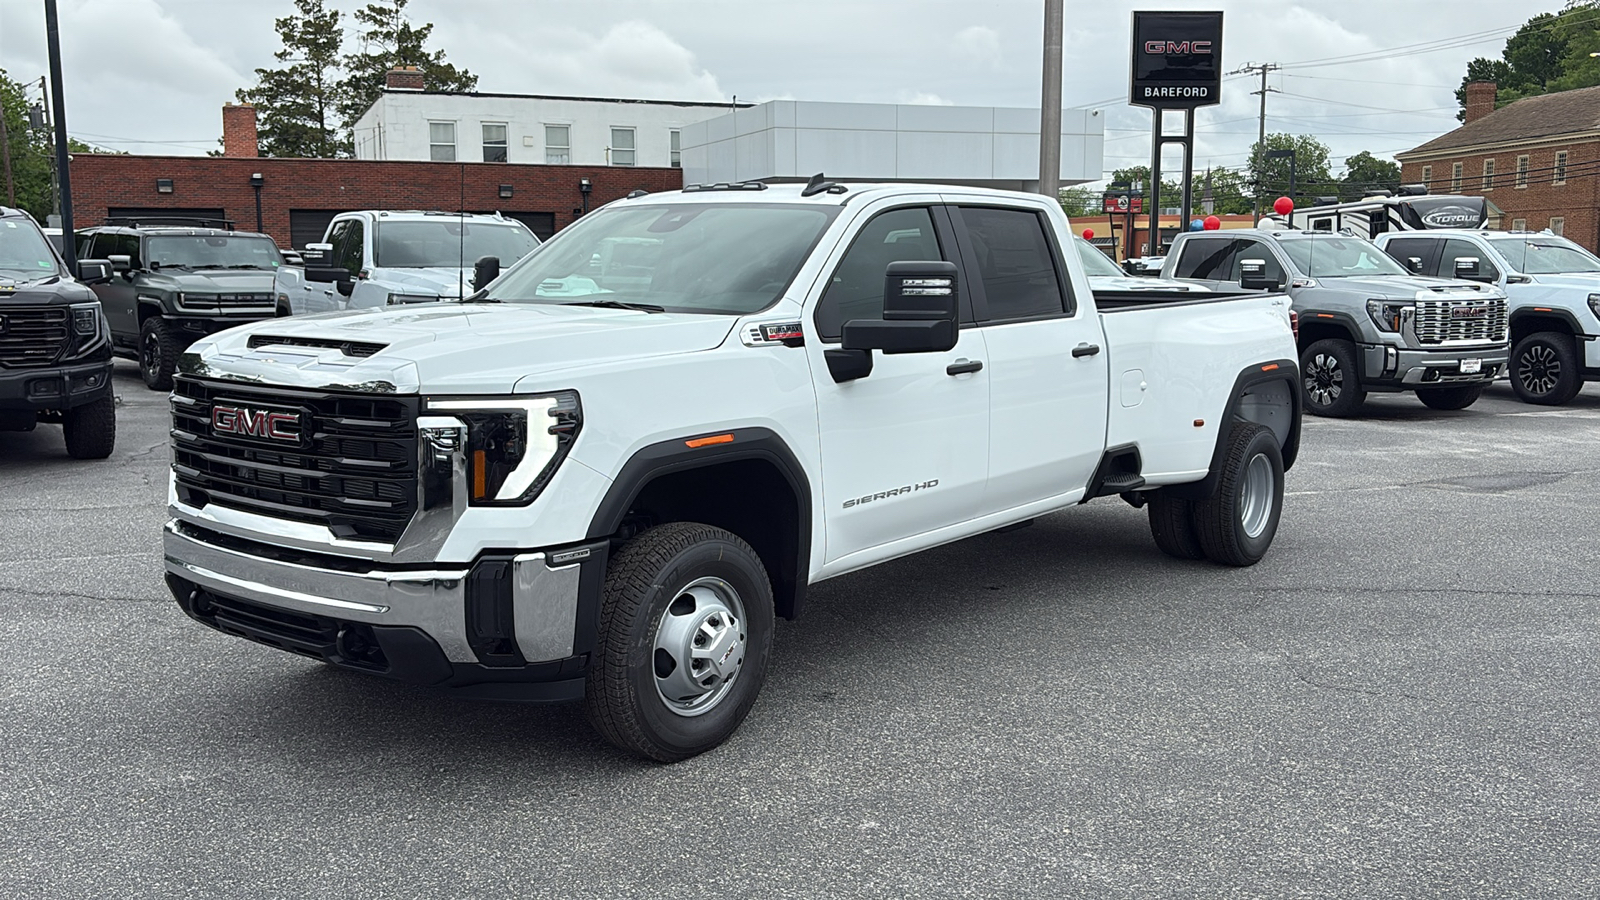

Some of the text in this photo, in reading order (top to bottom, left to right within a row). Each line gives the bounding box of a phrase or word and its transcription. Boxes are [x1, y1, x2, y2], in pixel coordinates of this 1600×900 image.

[1145, 41, 1211, 53] GMC
[1144, 87, 1208, 97] BAREFORD
[212, 405, 300, 442] GMC
[842, 479, 939, 509] SIERRA HD
